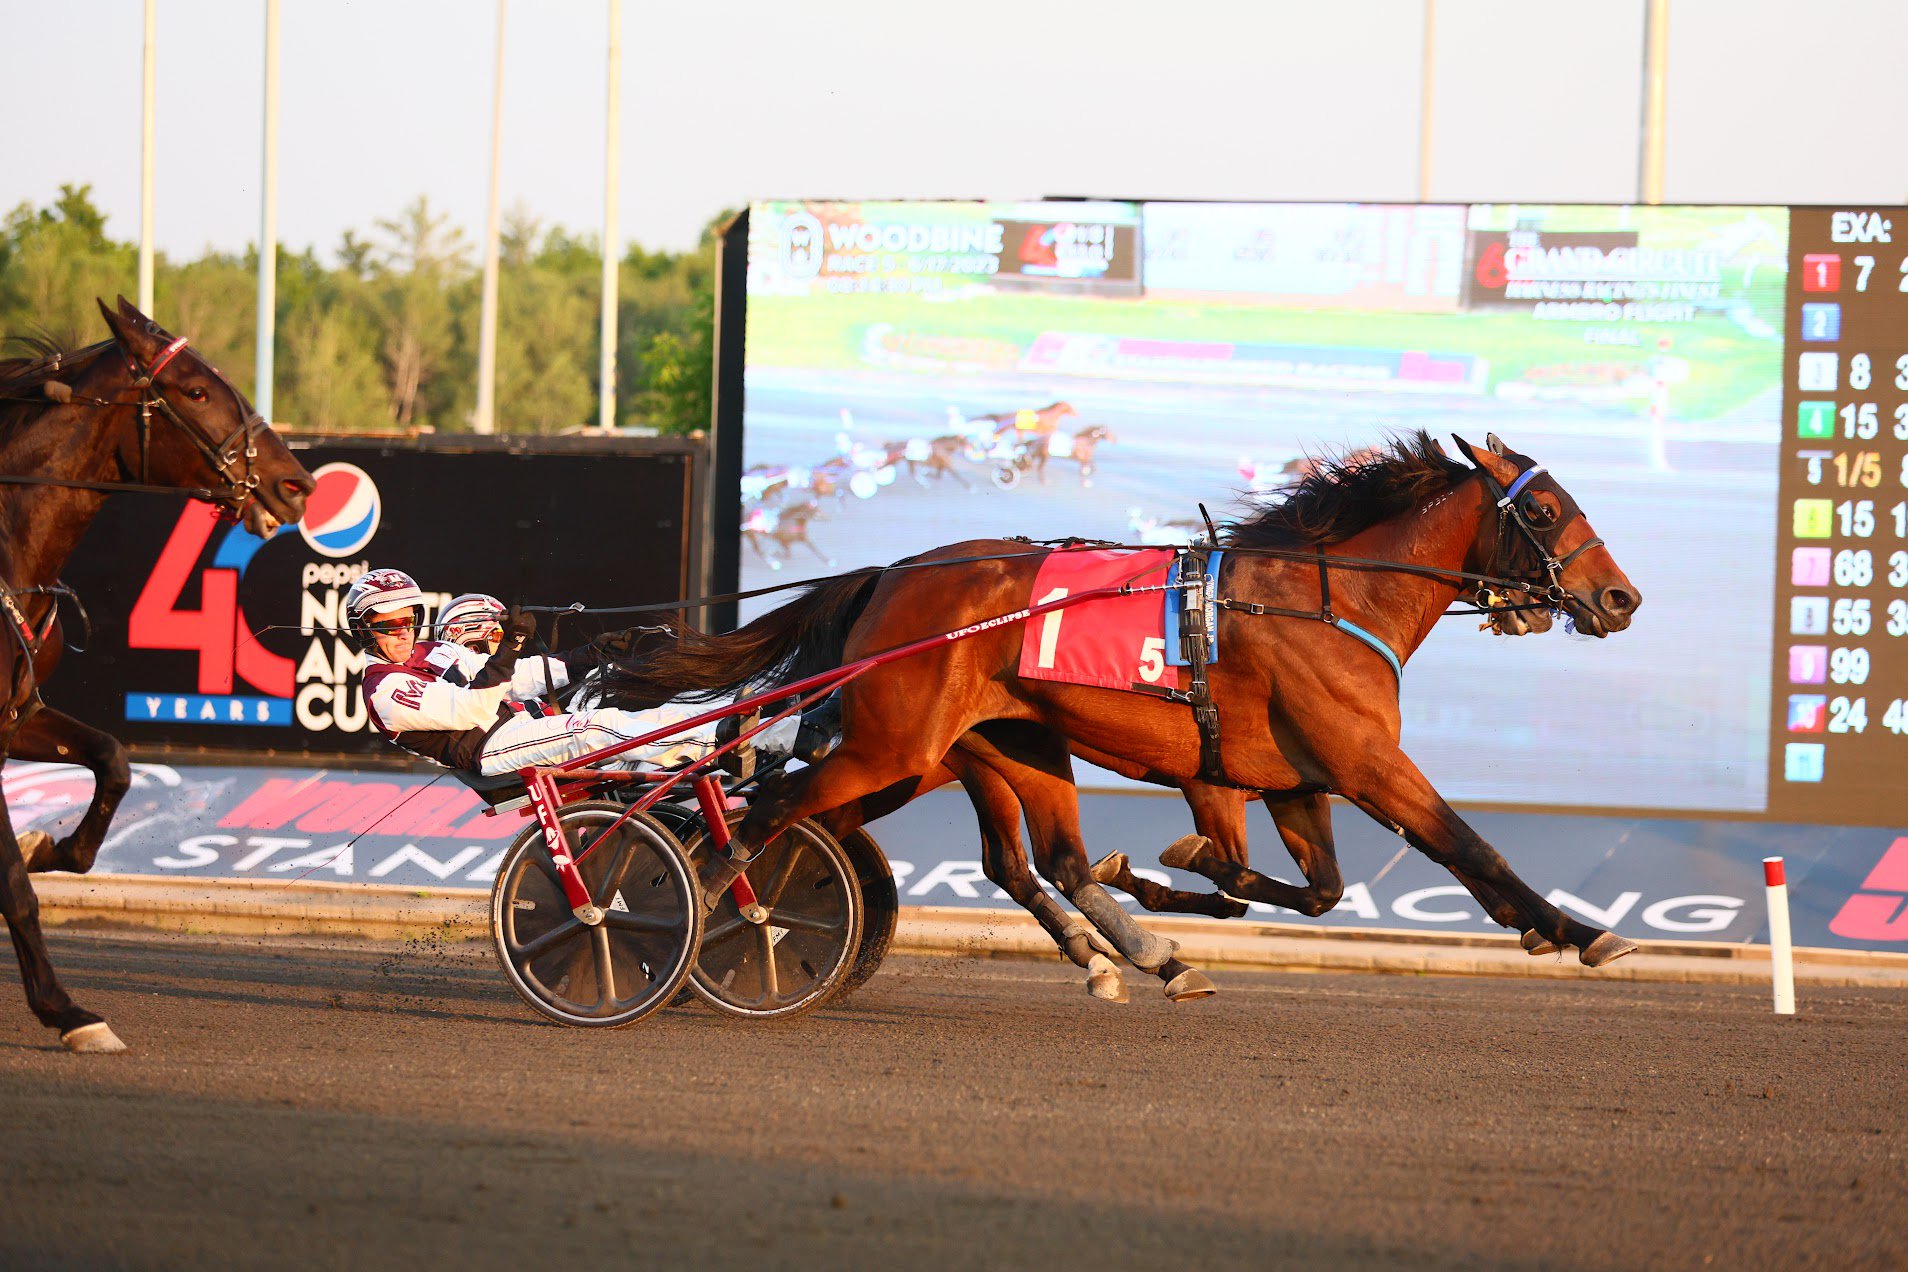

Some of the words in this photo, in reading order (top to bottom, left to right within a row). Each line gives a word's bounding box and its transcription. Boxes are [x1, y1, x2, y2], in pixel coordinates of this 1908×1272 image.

[828, 223, 1004, 254] WOODBINE
[1831, 211, 1892, 243] EXA:
[1815, 262, 1828, 288] 1
[1853, 255, 1876, 293] 7
[1812, 309, 1828, 338] 2
[1850, 353, 1872, 391] 8
[1808, 408, 1823, 435] 4
[1839, 402, 1879, 440] 15
[1833, 451, 1882, 488] 1/5
[1836, 500, 1876, 538] 15
[1037, 588, 1068, 669] 1
[1832, 598, 1872, 636] 55
[1138, 637, 1166, 683] 5
[1830, 647, 1871, 684] 99
[146, 696, 270, 723] YEARS
[296, 682, 381, 734] CU
[1827, 695, 1868, 734] 24
